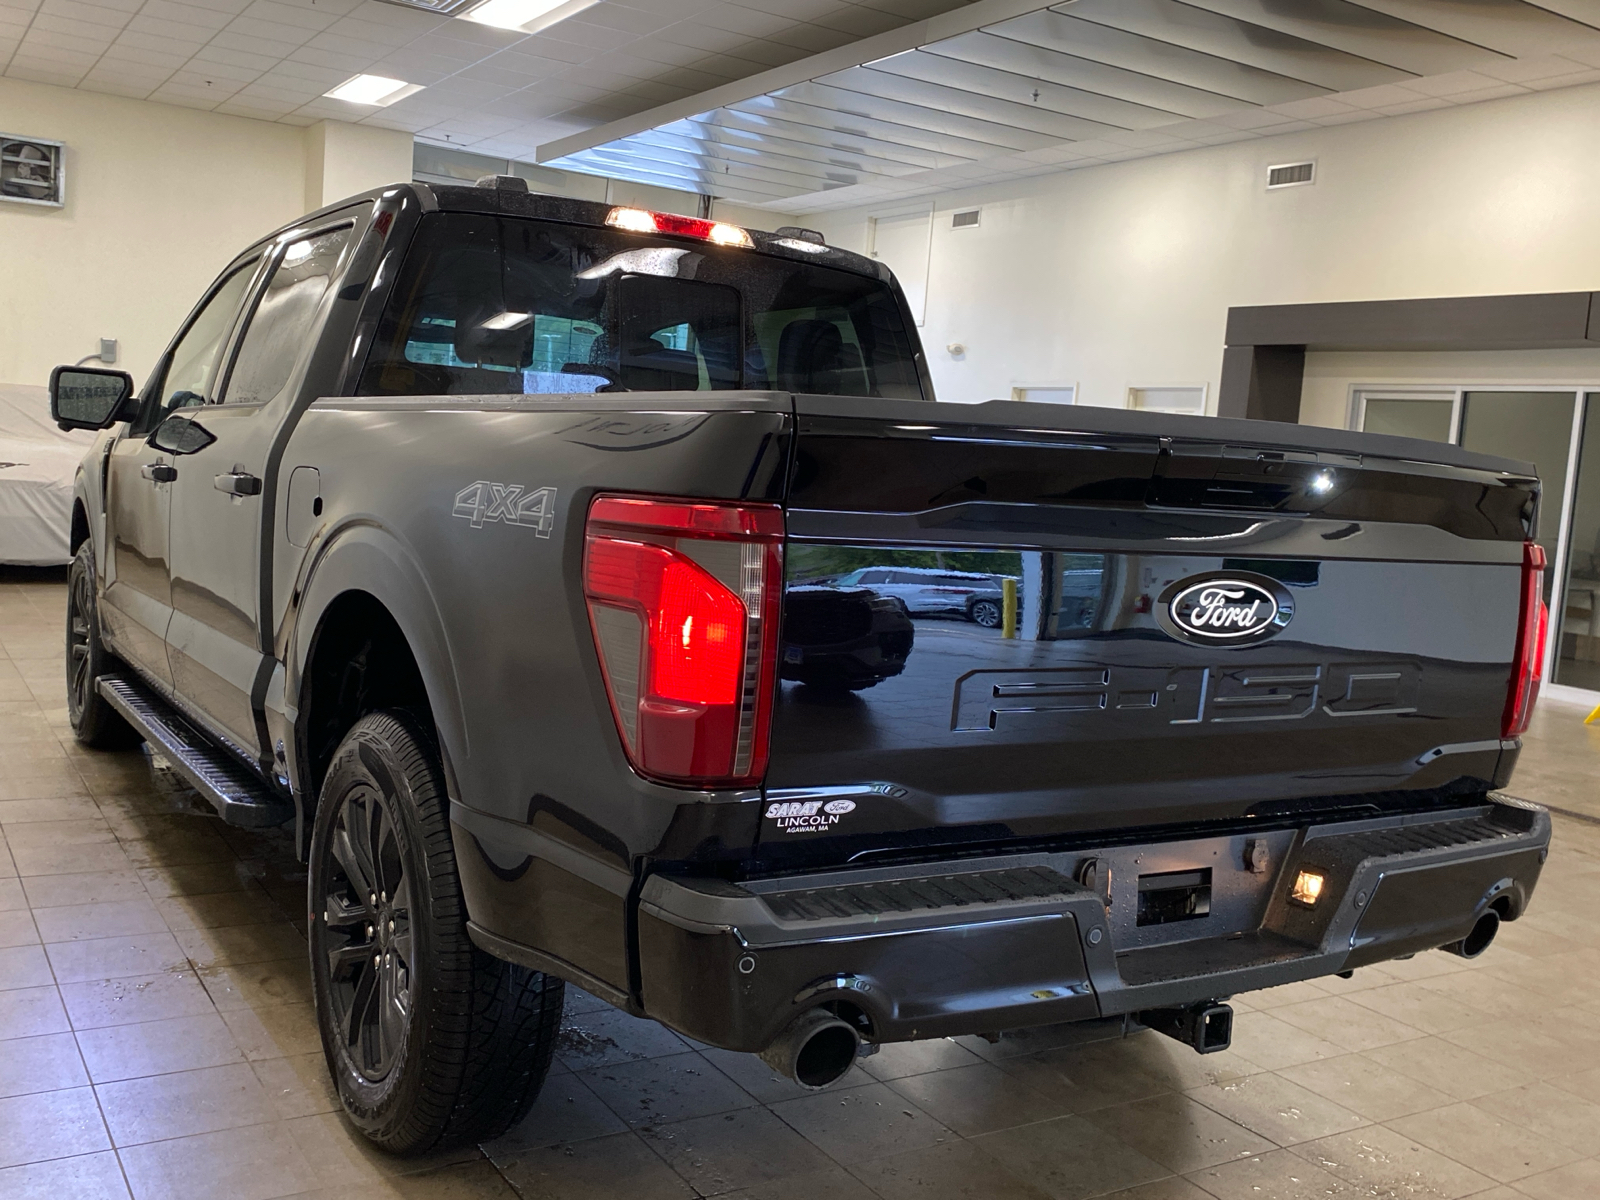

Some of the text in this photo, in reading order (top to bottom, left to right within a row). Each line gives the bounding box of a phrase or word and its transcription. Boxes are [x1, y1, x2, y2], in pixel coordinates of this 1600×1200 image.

[452, 480, 557, 539] 4X4
[1190, 588, 1261, 627] Ford
[951, 662, 1425, 733] F-150
[765, 801, 823, 818] SARAT
[777, 815, 839, 827] LINCOLN
[786, 825, 817, 833] AGAWAM,
